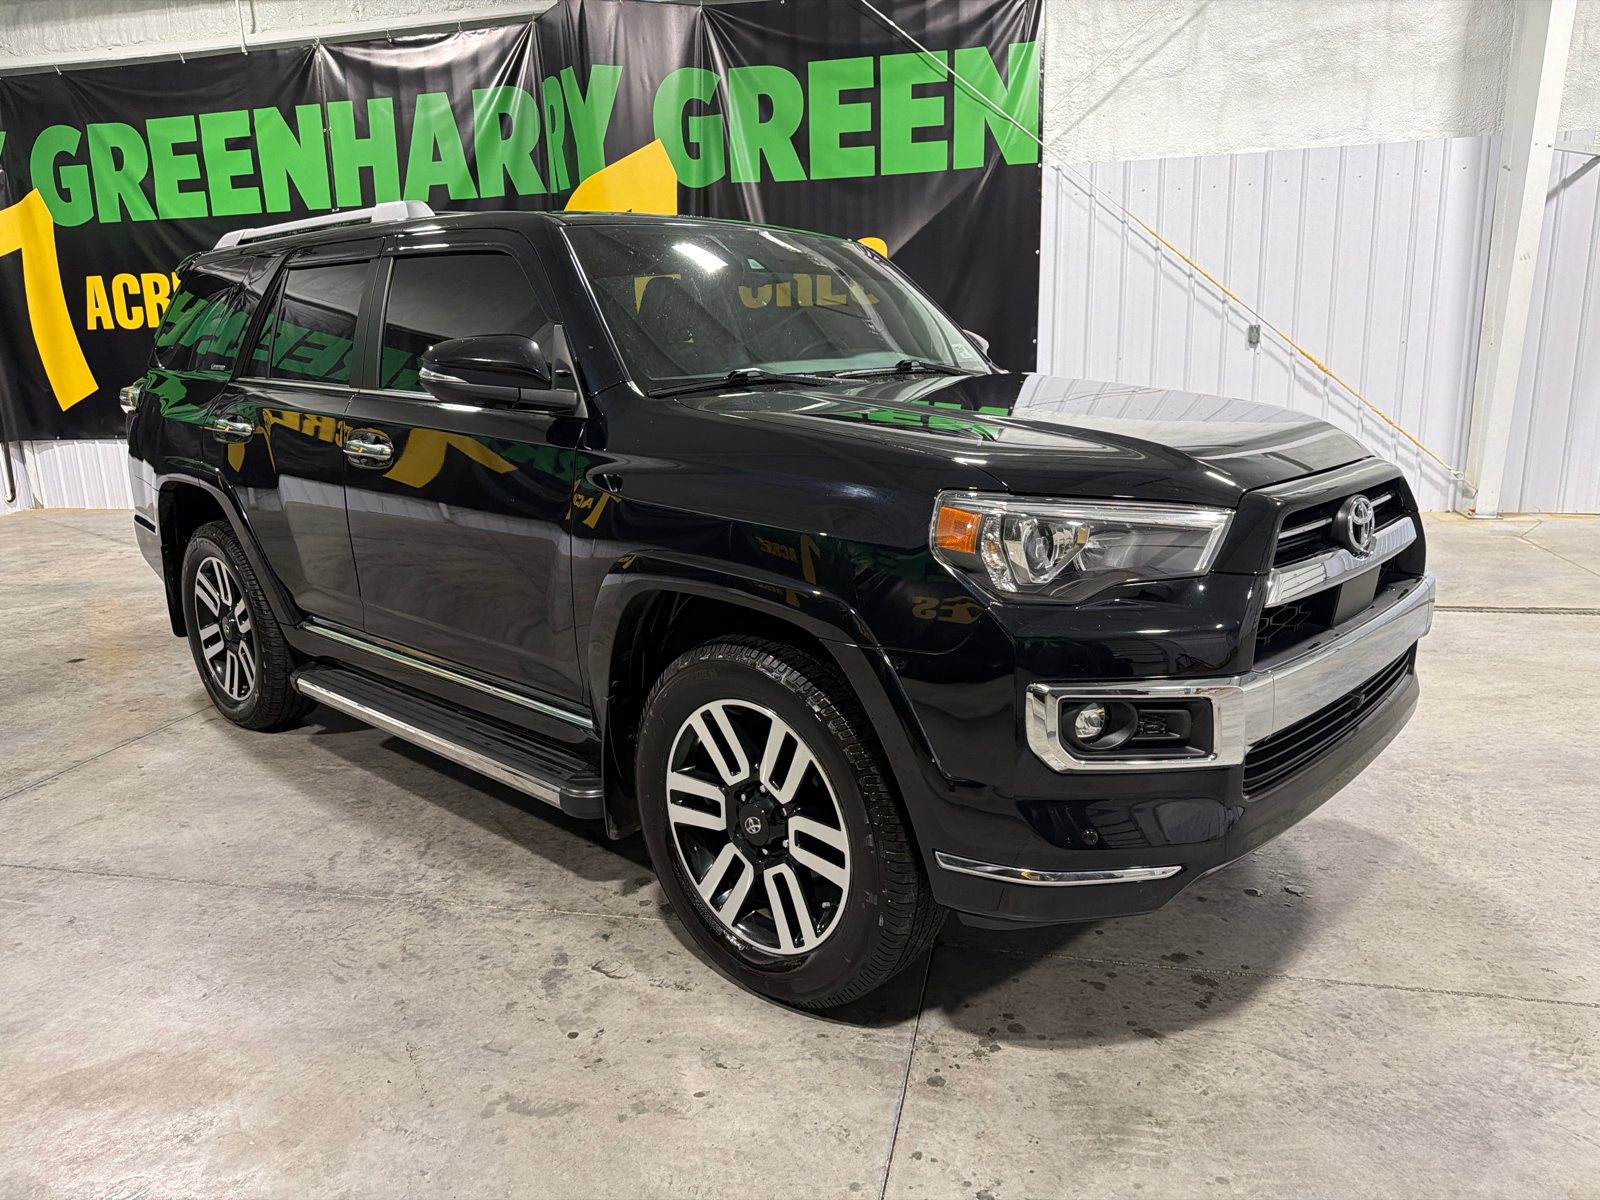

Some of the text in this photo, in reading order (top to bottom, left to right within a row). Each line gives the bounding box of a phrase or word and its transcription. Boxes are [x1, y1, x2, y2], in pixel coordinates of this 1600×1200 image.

[30, 103, 332, 227] GREEN
[327, 64, 624, 208] HARRY
[653, 41, 1041, 188] GREEN
